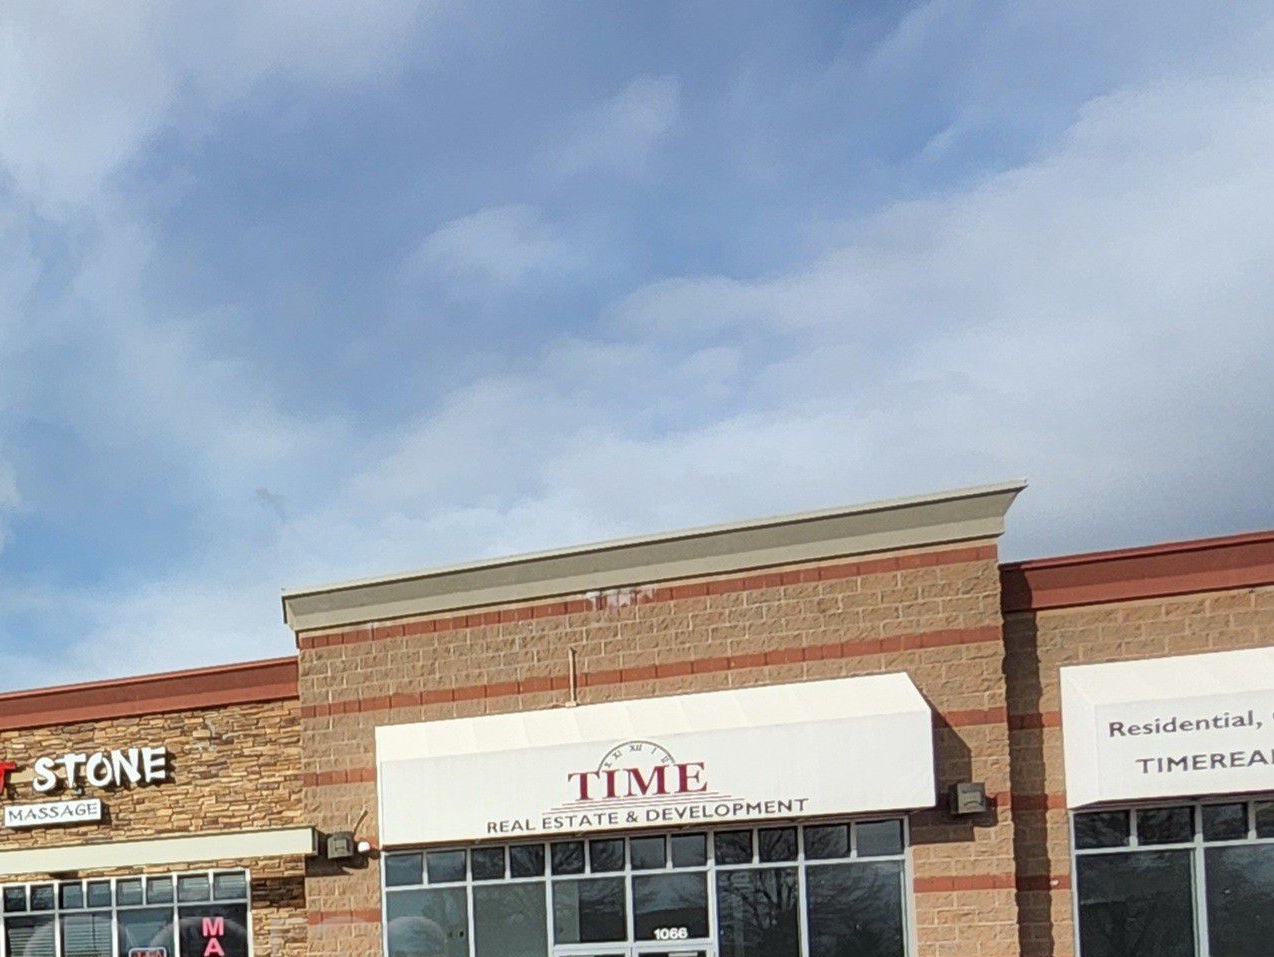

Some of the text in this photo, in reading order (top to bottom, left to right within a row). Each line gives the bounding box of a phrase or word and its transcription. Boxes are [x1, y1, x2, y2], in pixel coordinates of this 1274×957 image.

[1109, 709, 1264, 738] Residential,
[32, 746, 167, 793] STONE
[567, 761, 708, 802] TIME
[8, 802, 98, 824] MASSAGE
[487, 797, 810, 834] REAL ESTATE & DEVELOPMENT
[653, 926, 689, 941] 1066
